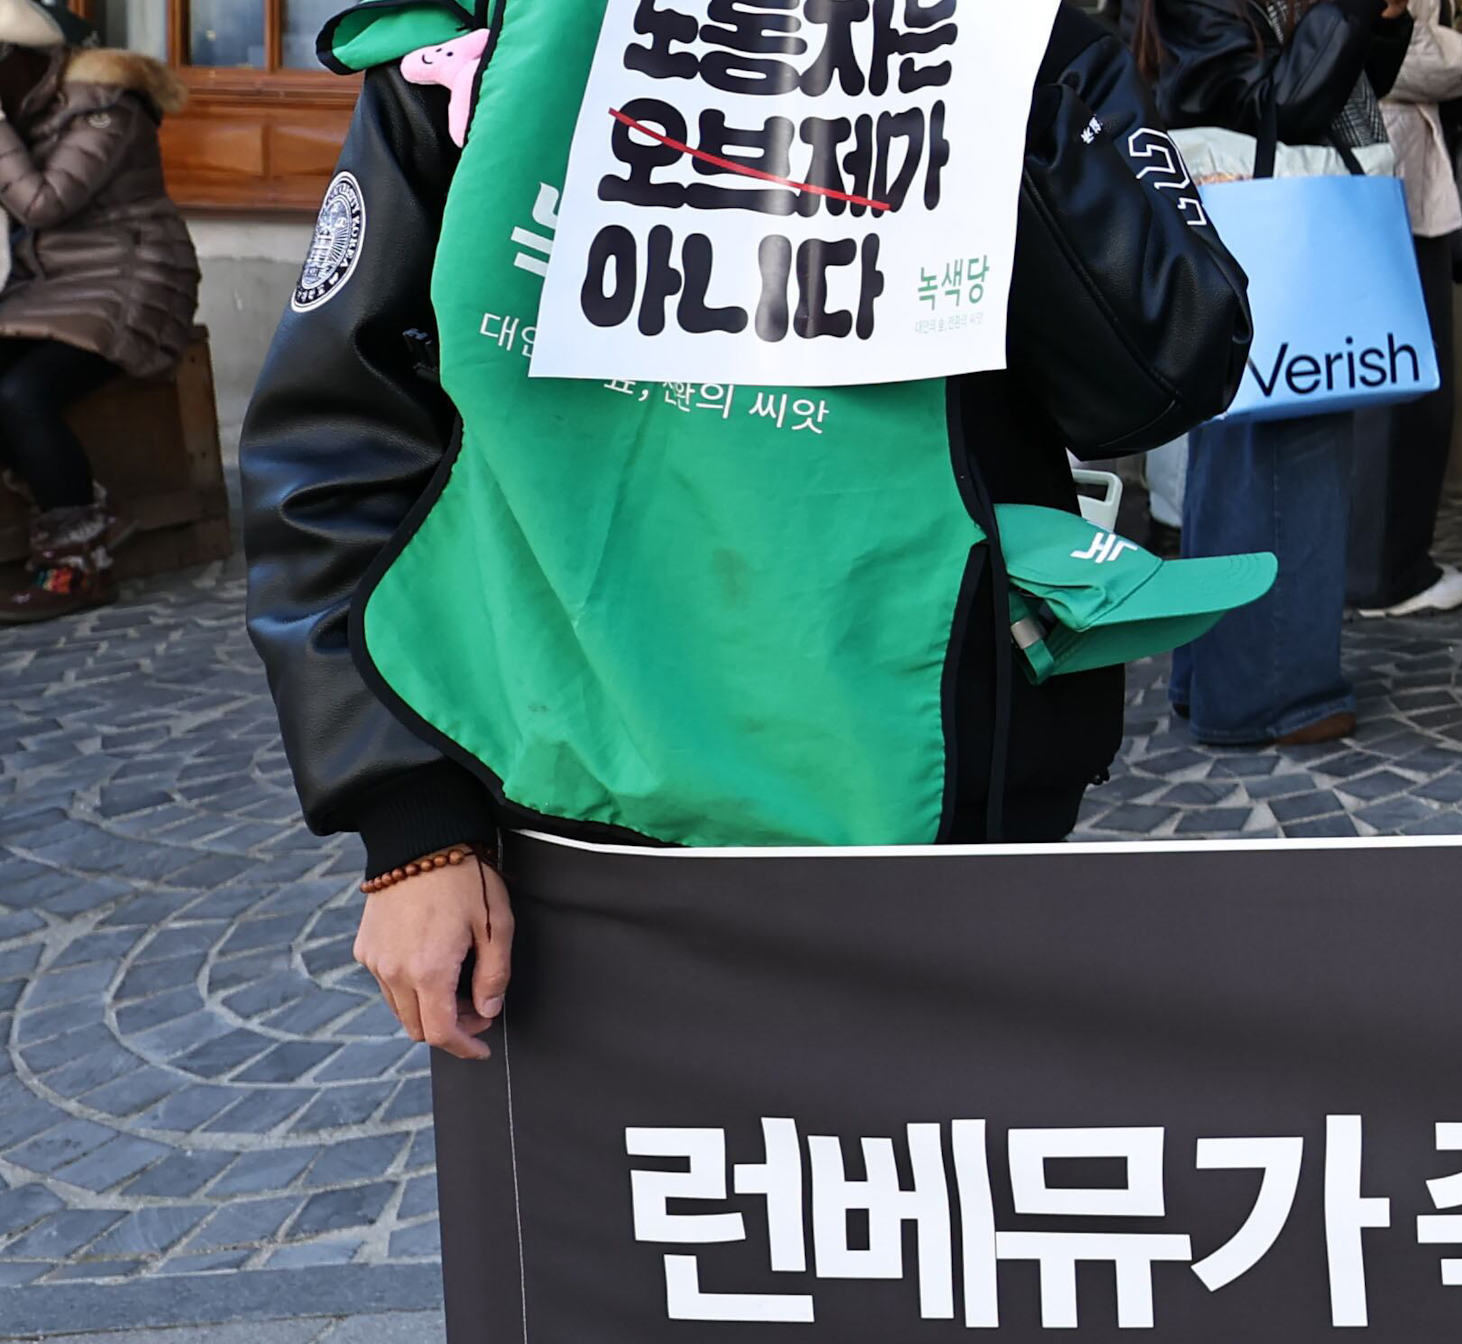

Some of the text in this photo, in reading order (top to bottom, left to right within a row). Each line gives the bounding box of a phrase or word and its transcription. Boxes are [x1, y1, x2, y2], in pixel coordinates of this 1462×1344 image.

[598, 97, 949, 217] 오브제가
[581, 224, 885, 343] 아니다
[918, 254, 990, 311] 녹색당
[1247, 332, 1420, 398] Verish
[748, 392, 829, 435] 씨앗
[624, 1113, 1391, 1329] 런베뮤가
